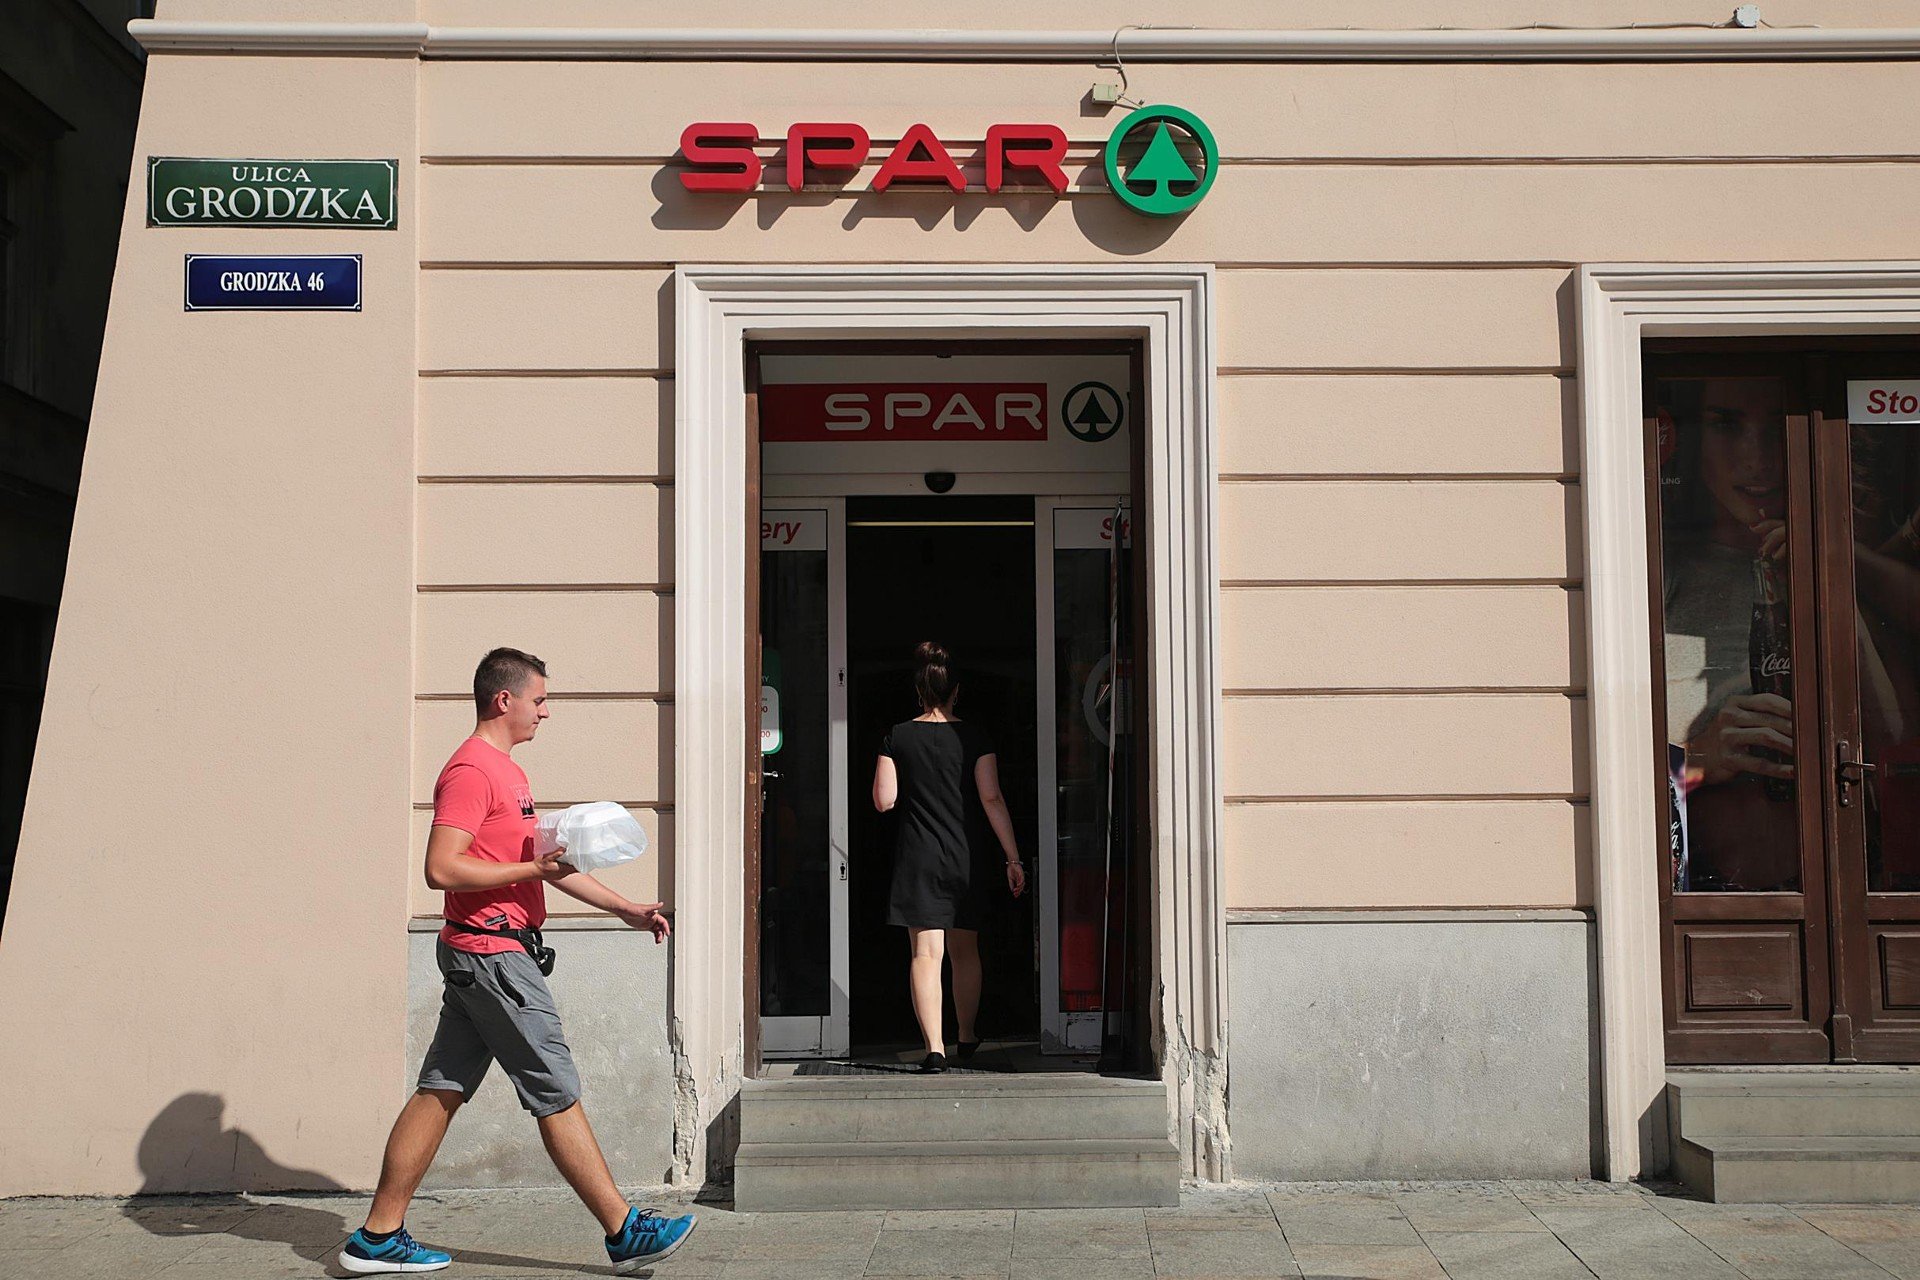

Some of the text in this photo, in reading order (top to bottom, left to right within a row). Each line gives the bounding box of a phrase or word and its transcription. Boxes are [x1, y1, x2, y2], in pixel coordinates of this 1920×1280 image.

[679, 122, 1069, 195] SPAR
[232, 166, 312, 182] ULICA
[165, 186, 383, 221] GRODZKA
[220, 271, 325, 292] GRODZKA 46
[824, 392, 1043, 431] SPAR
[1867, 389, 1920, 414] Sto
[761, 521, 802, 544] ery
[1100, 517, 1132, 539] St
